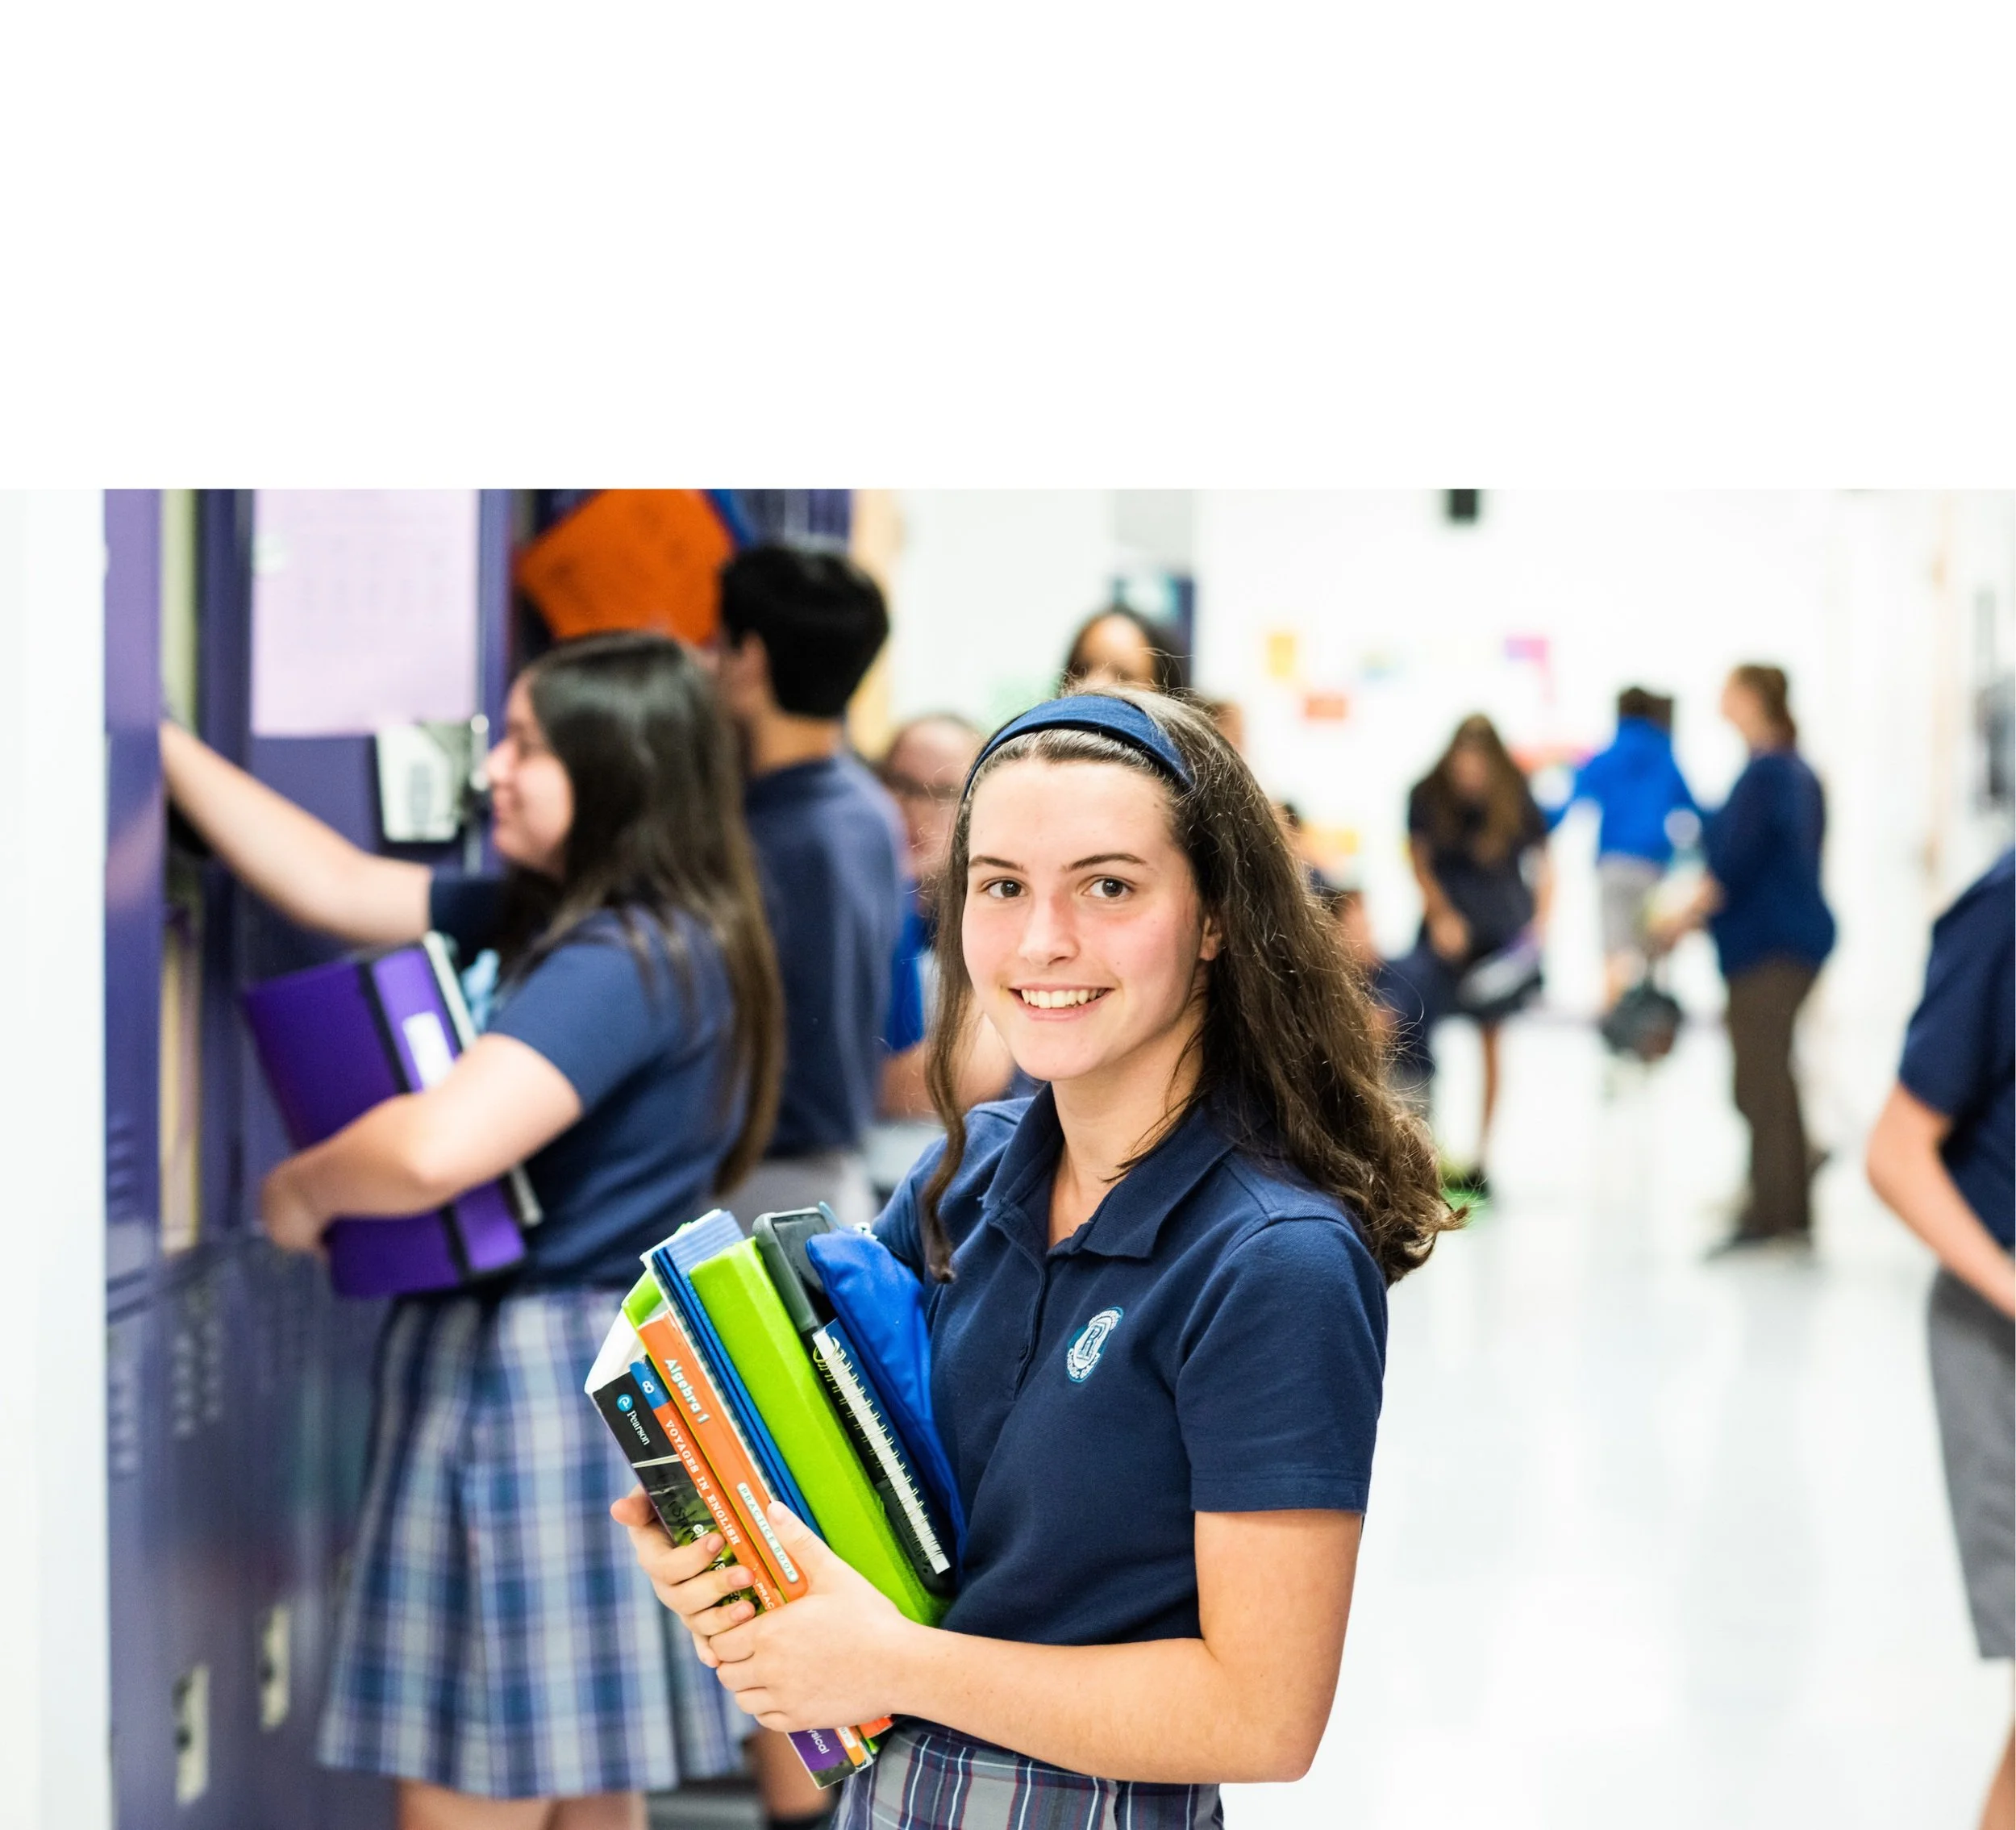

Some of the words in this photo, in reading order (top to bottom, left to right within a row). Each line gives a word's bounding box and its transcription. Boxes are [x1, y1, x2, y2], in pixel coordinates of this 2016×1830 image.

[642, 1380, 655, 1394] 8
[664, 1359, 702, 1415] Algebra
[697, 1413, 710, 1424] 1
[626, 1410, 650, 1446] Pearson
[665, 1419, 700, 1474] VOYAGES
[696, 1476, 710, 1490] IN
[706, 1494, 741, 1545] ENGLISH
[741, 1487, 774, 1542] PRACTICE
[775, 1547, 794, 1576] BOOK
[756, 1582, 775, 1610] PRAC
[807, 1728, 830, 1755] ysical
